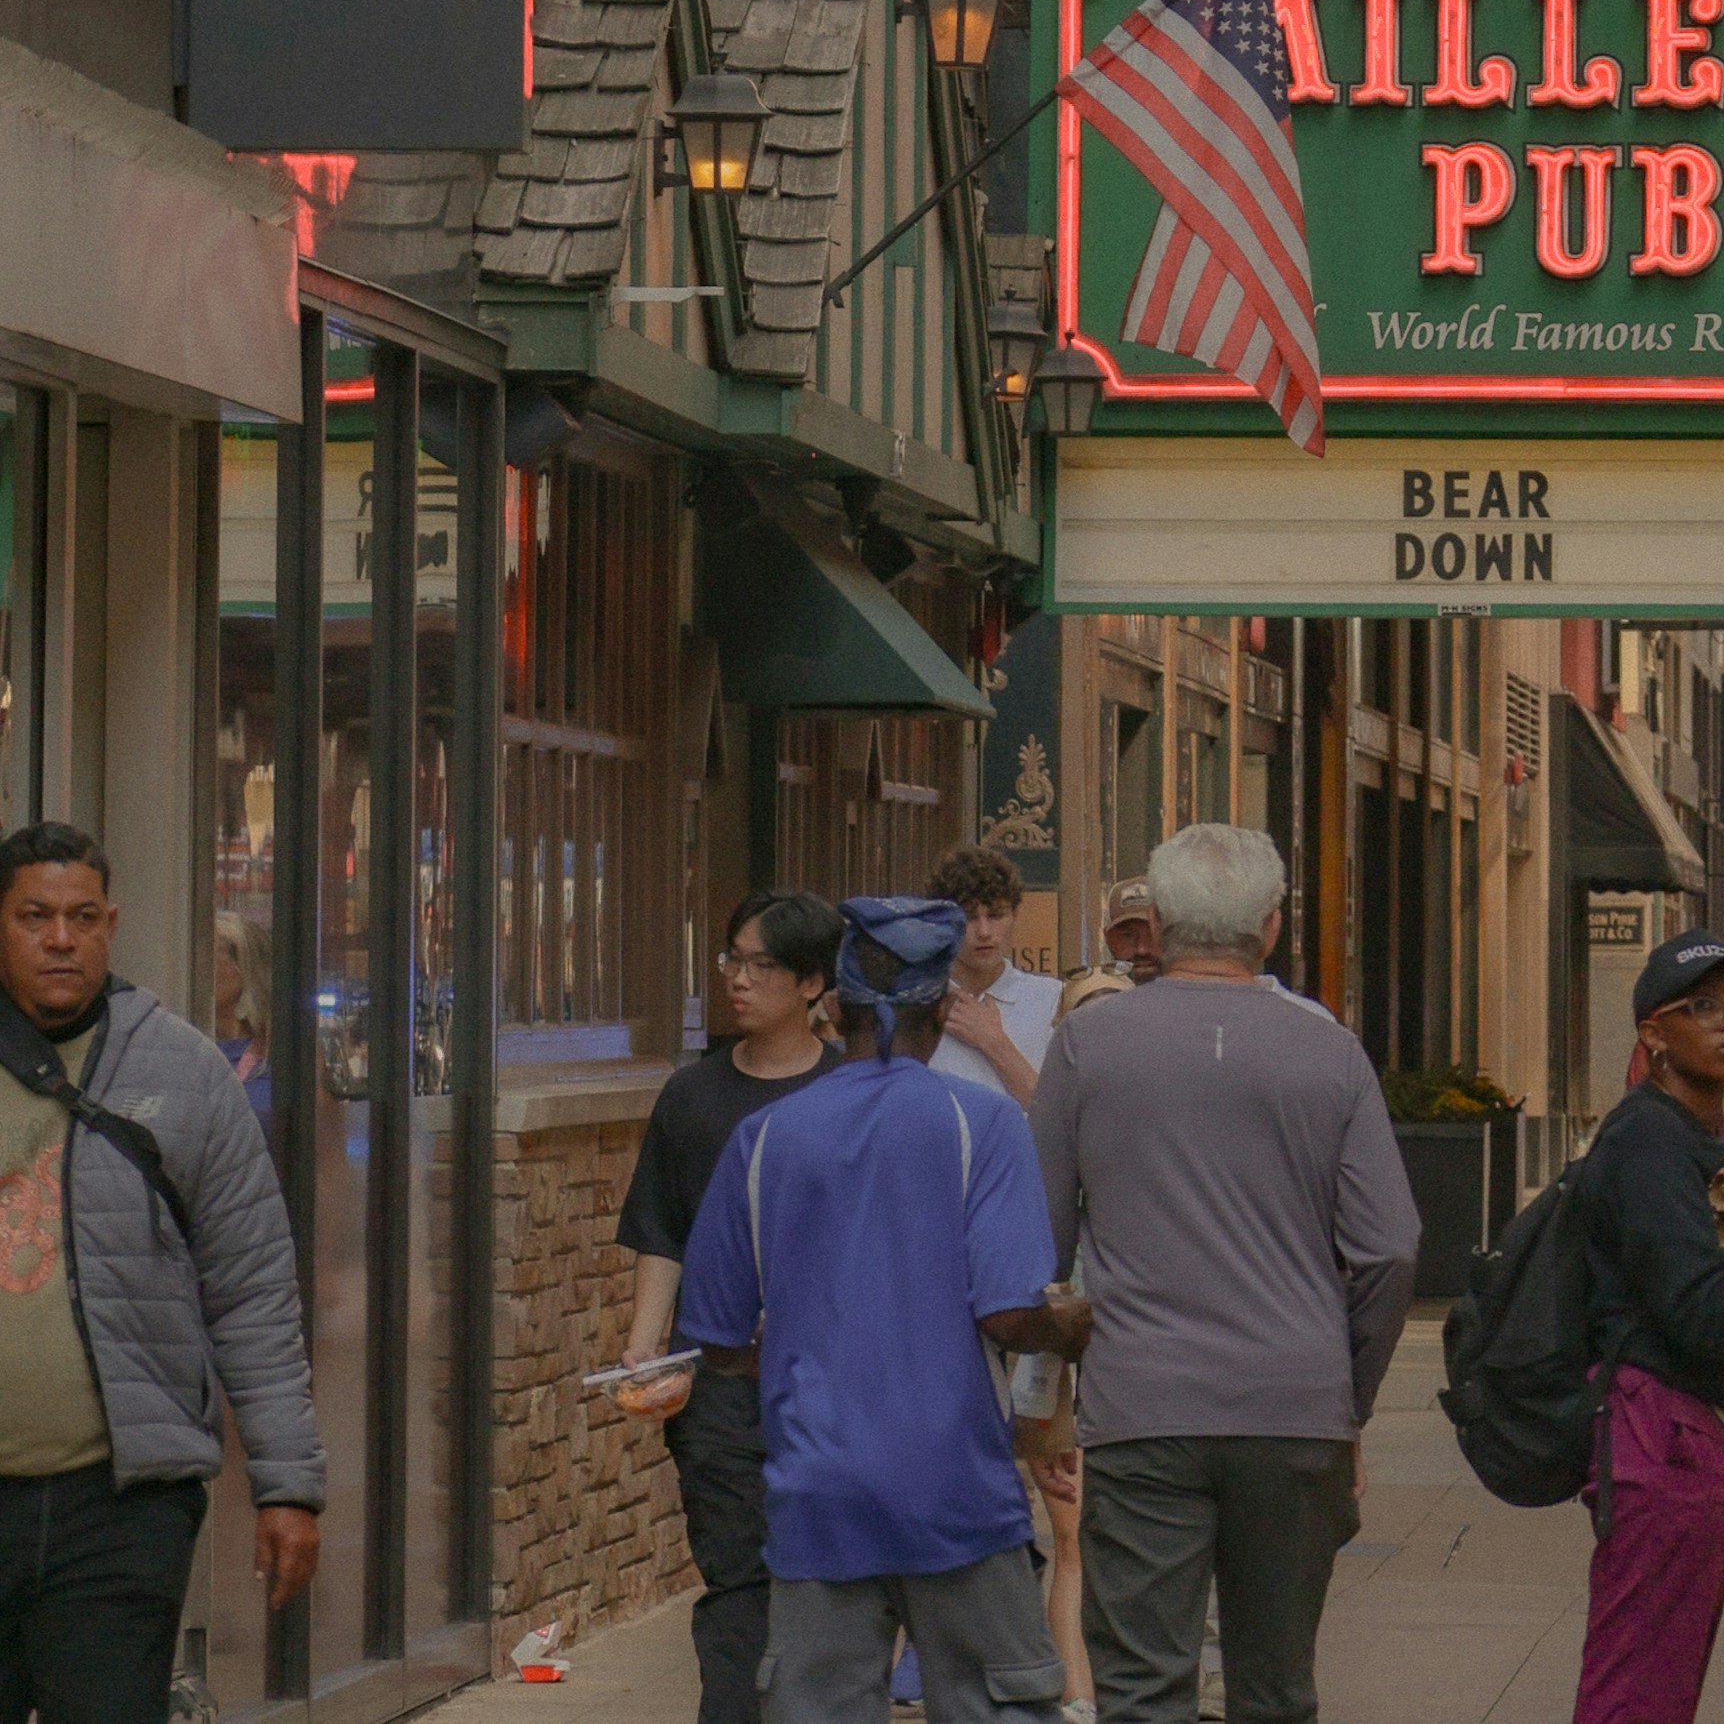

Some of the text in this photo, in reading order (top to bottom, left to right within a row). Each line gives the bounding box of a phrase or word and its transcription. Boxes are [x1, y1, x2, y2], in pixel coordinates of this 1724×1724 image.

[1419, 141, 1724, 279] PUB
[1367, 304, 1506, 351] World
[1511, 312, 1676, 351] Famous
[1403, 469, 1551, 518] BEAR
[1395, 532, 1553, 581] DOWN
